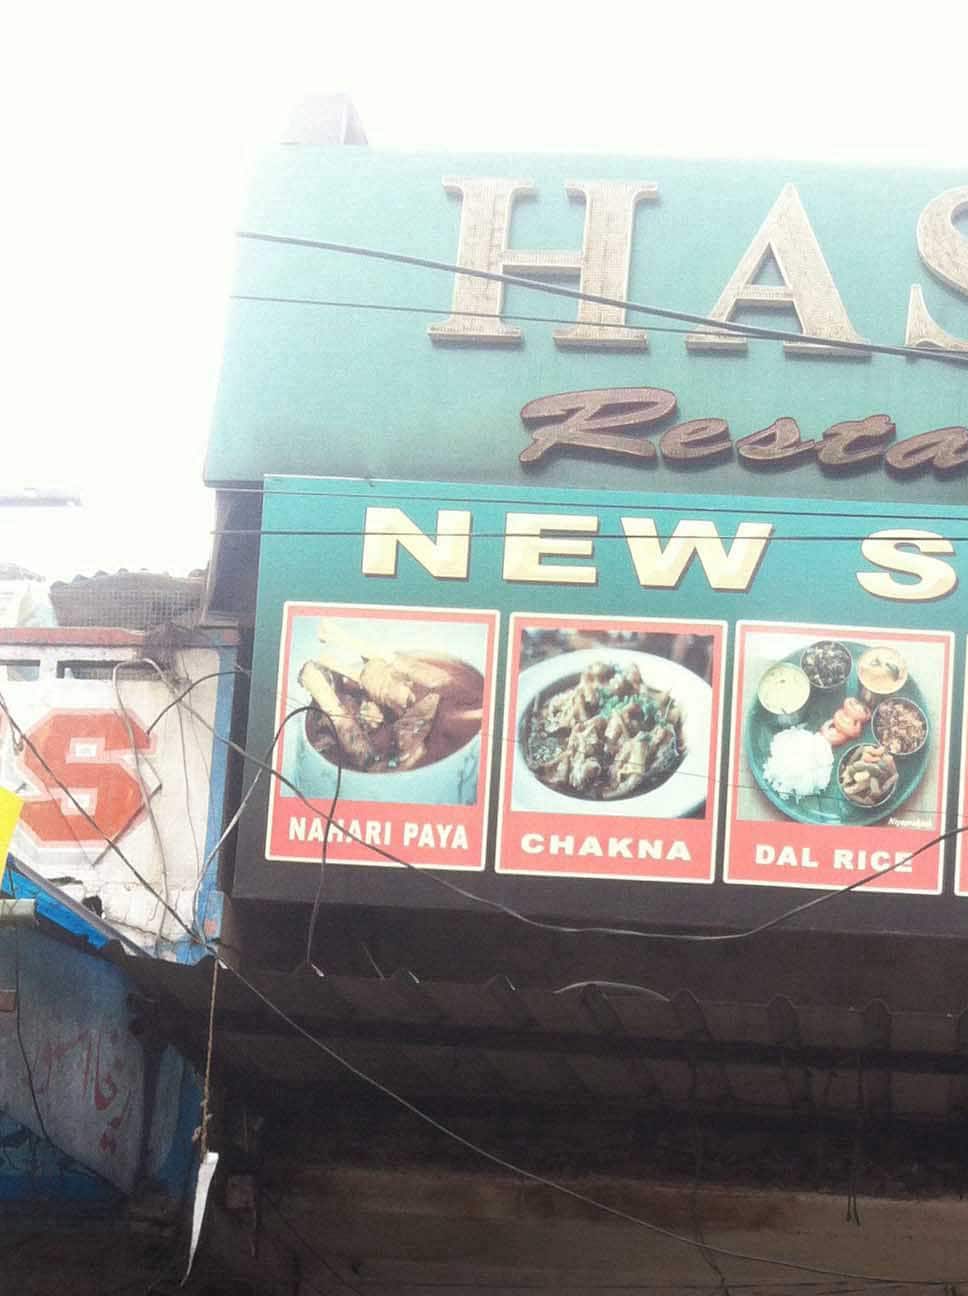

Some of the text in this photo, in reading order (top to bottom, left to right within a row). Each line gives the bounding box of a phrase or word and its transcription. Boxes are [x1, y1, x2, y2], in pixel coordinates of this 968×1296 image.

[361, 507, 774, 591] NEW
[288, 815, 470, 850] NAHARI PAYA
[520, 832, 692, 863] CHAKNA
[755, 842, 914, 874] DAL RICE
